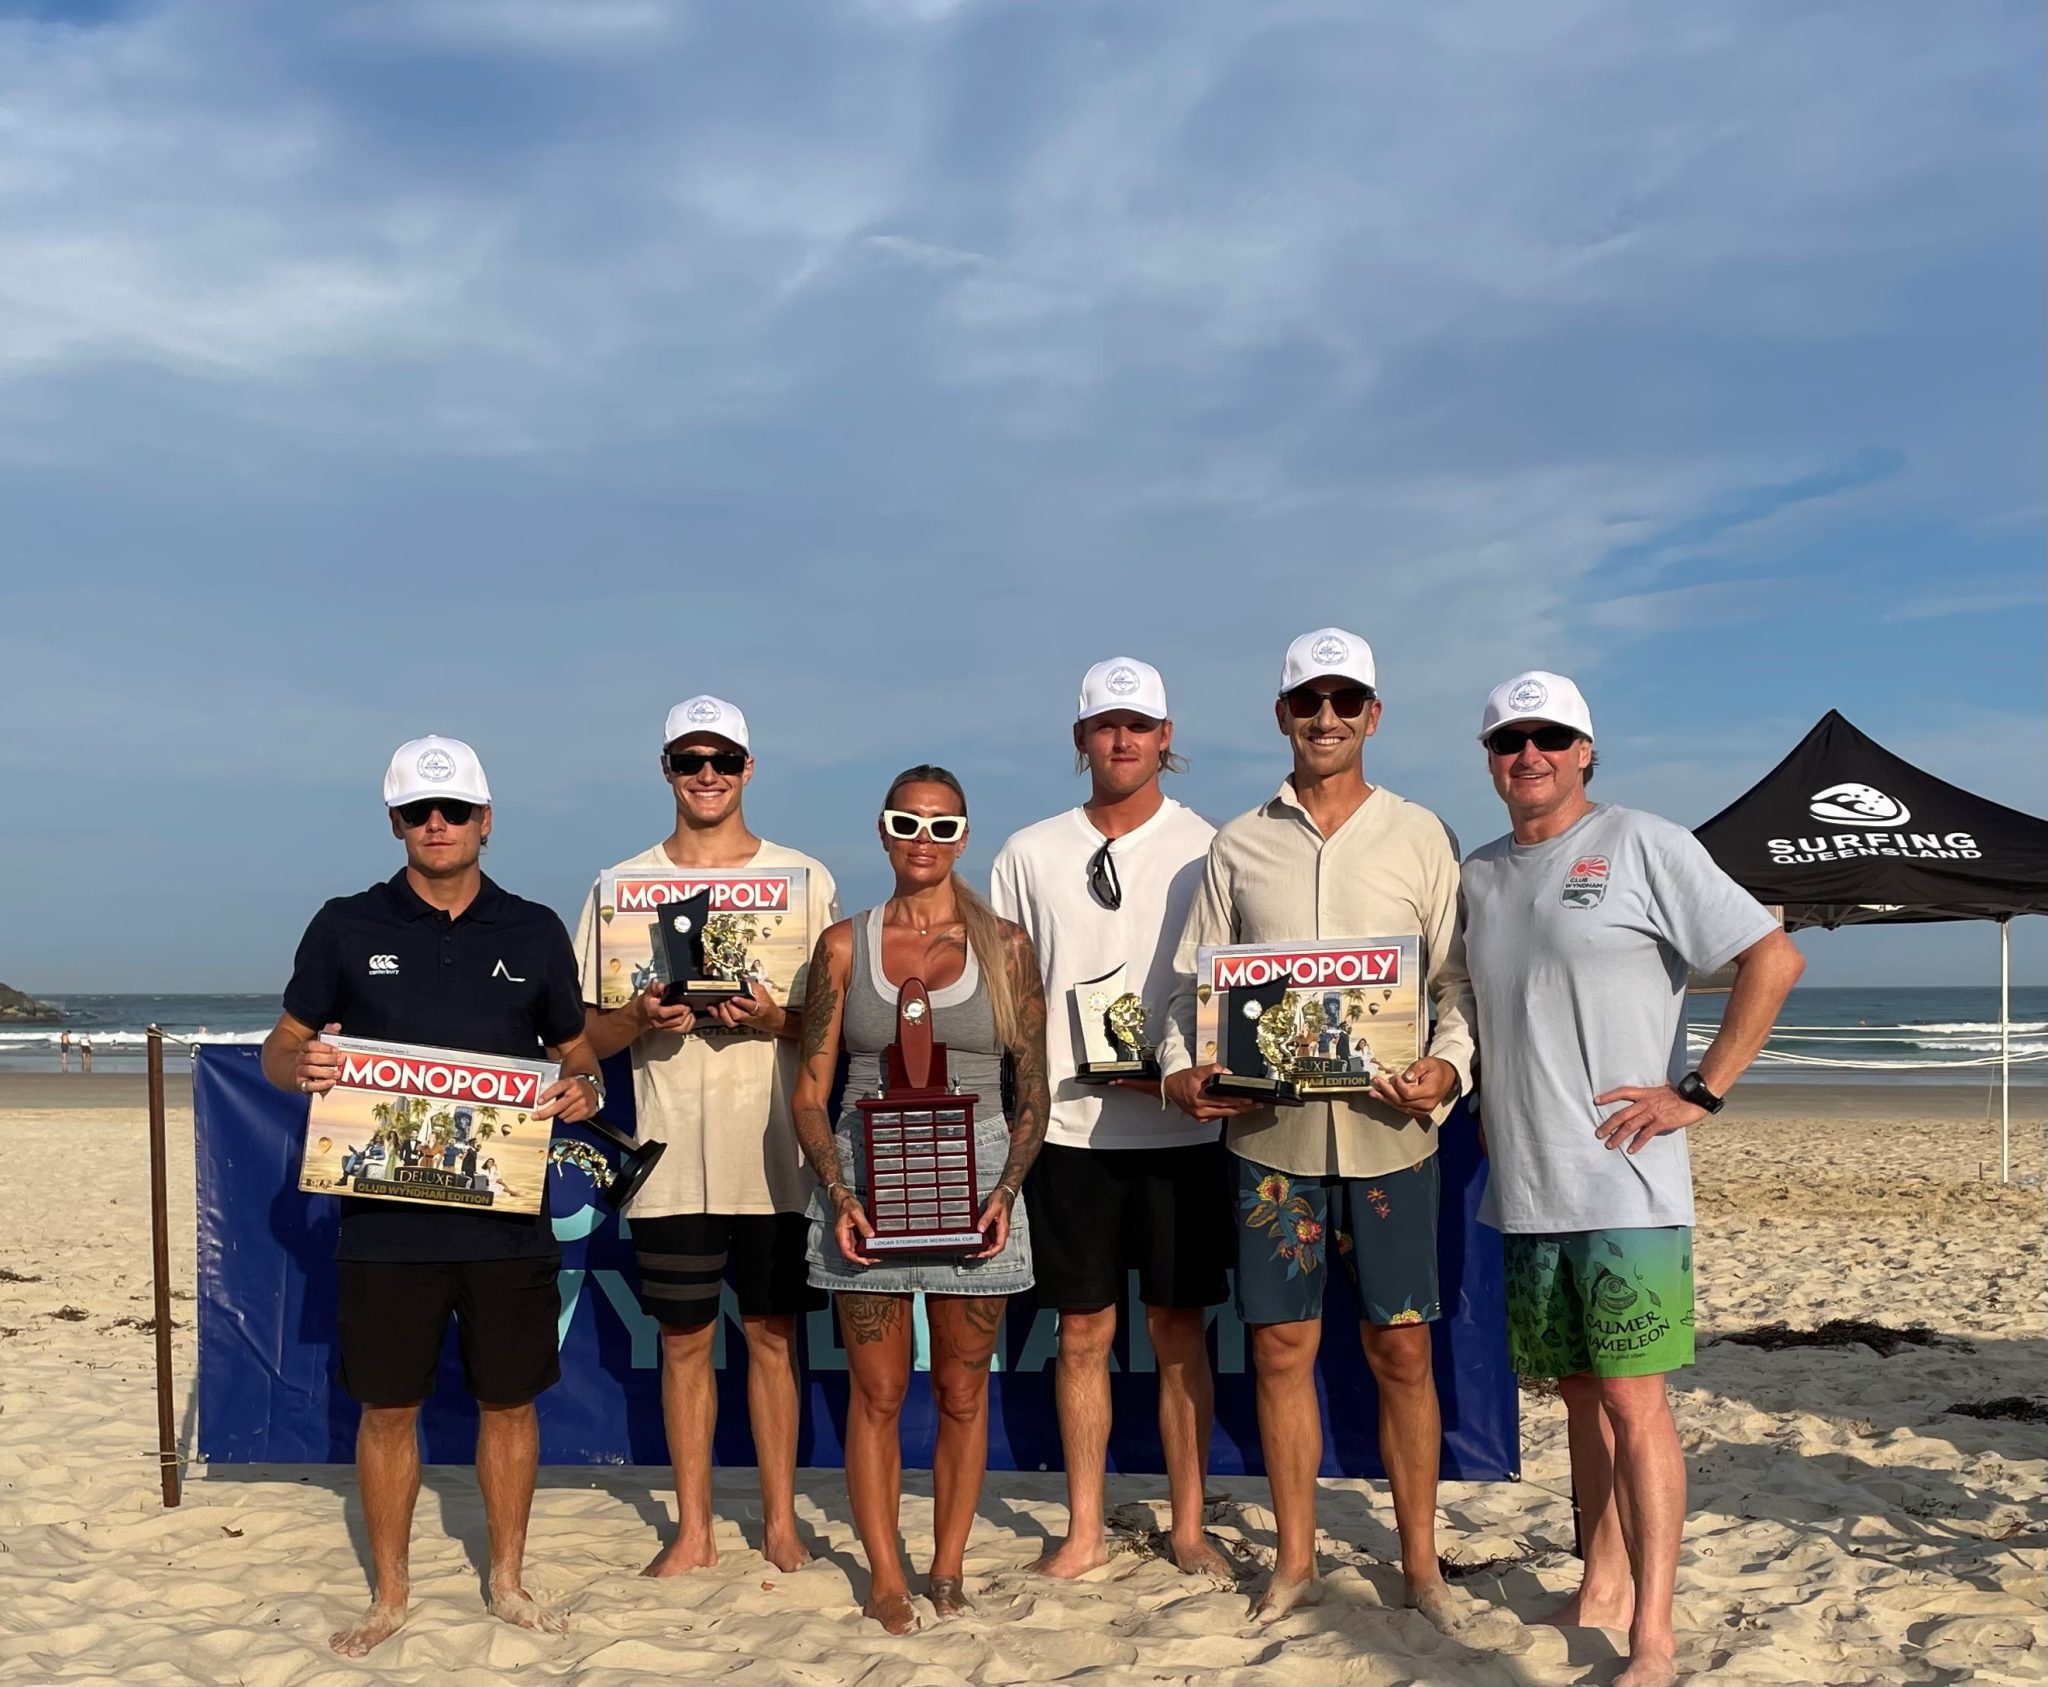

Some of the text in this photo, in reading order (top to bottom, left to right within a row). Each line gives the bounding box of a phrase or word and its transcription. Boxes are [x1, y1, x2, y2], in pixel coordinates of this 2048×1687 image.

[1767, 832, 1978, 855] SURFING
[1772, 847, 1983, 865] QUEENSLAND
[369, 968, 400, 976] canterbury
[1218, 952, 1395, 988] MONOPOLY
[341, 1056, 536, 1104] MONOPOLY
[1326, 1076, 1367, 1086] EDITION
[400, 1169, 454, 1187] DELUXE
[357, 1182, 490, 1204] CLUB WYNDHAM EDITION
[1585, 1310, 1661, 1335] CALMER
[1585, 1318, 1671, 1352] HAMELEON
